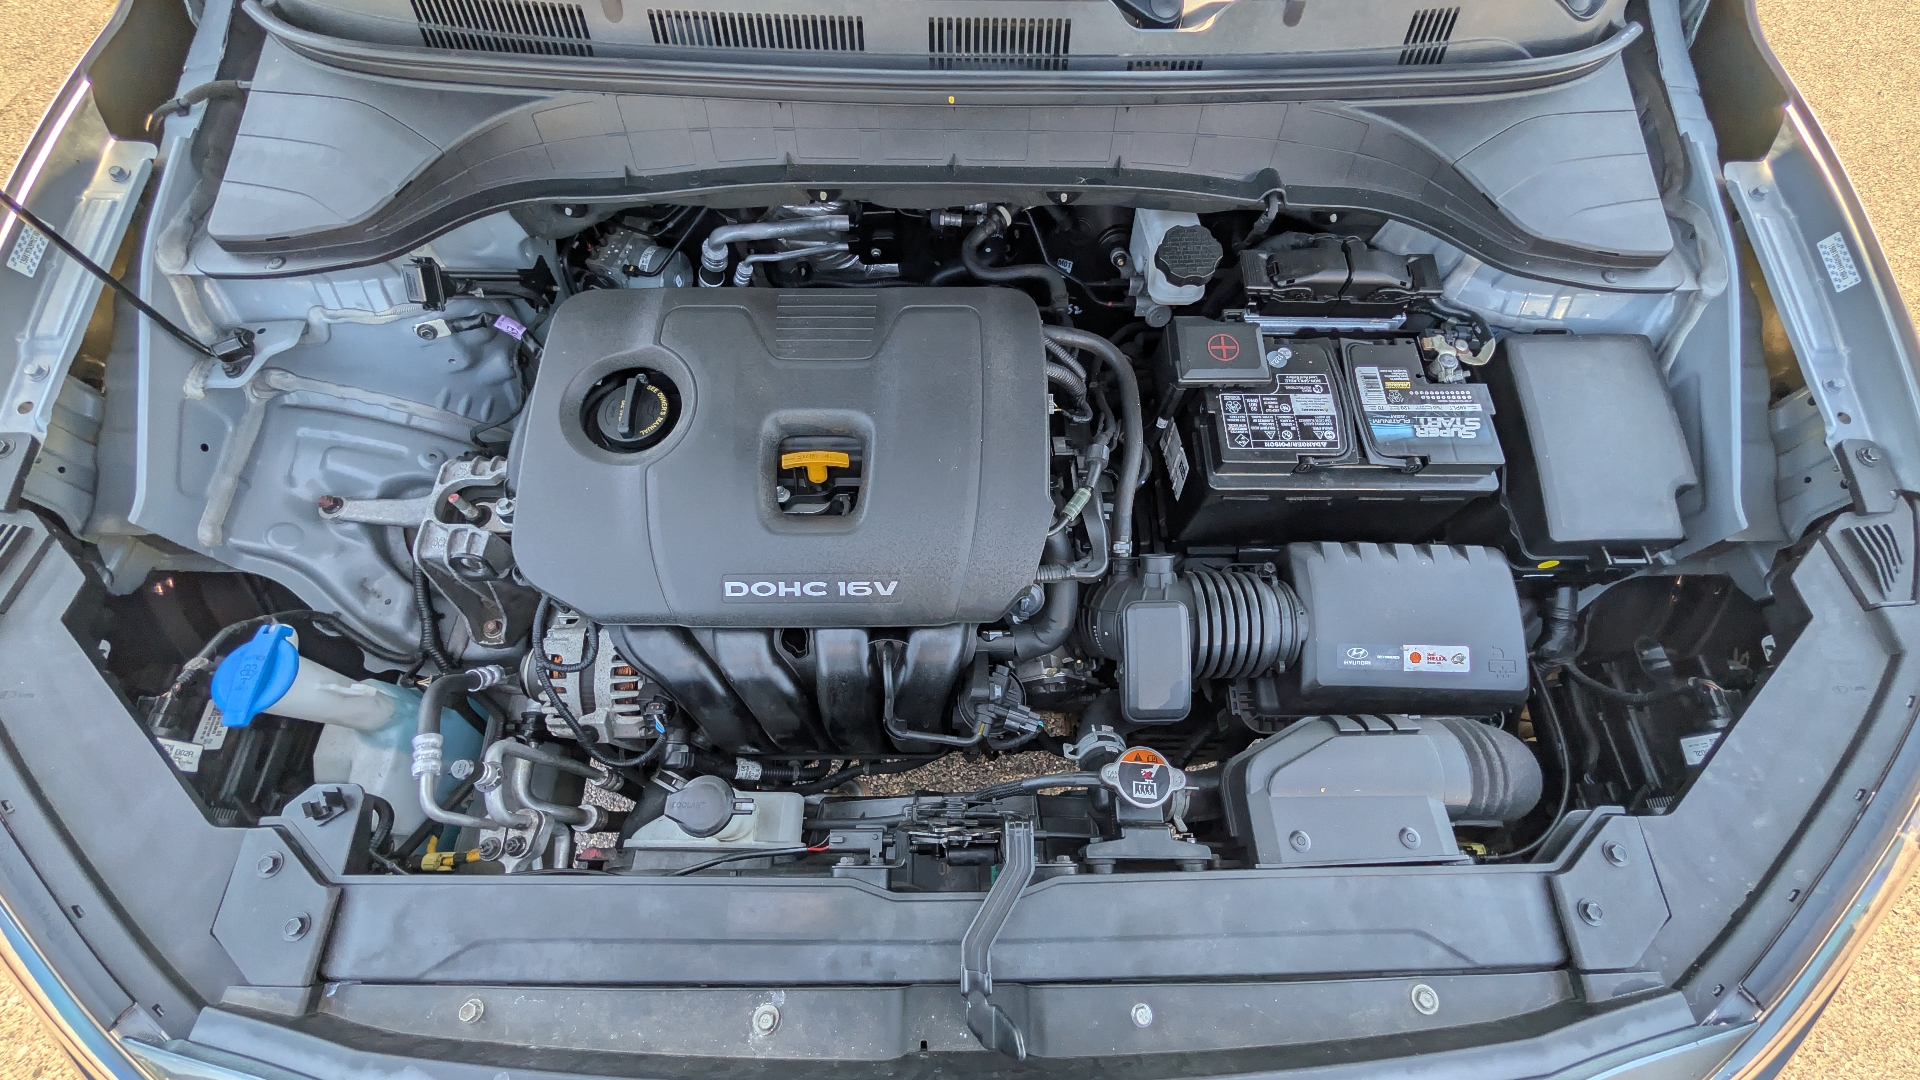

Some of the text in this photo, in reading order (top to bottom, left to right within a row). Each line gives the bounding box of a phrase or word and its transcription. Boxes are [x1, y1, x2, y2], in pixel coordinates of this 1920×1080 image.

[646, 384, 660, 394] SEE
[639, 416, 664, 436] MANUAL
[1413, 417, 1481, 430] START
[1415, 428, 1477, 439] SUPER
[724, 581, 899, 597] DOHC 16V
[672, 801, 707, 809] COOLANT
